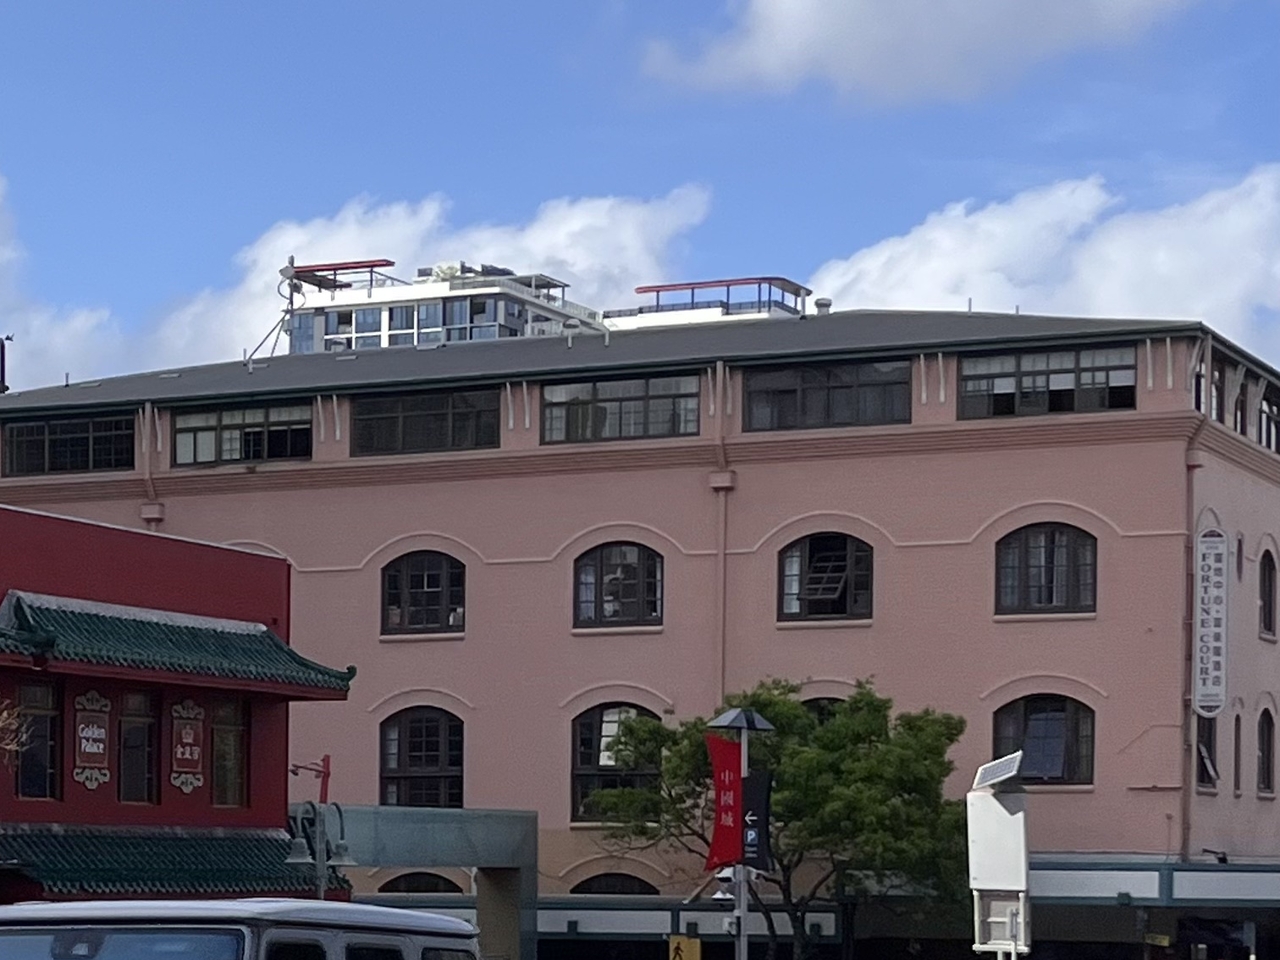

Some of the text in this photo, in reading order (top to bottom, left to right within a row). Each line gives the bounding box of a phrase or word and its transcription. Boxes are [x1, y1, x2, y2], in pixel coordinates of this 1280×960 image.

[1200, 552, 1212, 630] FORTUNE
[1199, 633, 1210, 687] COURT
[78, 723, 106, 739] Golden
[81, 739, 104, 754] Palace
